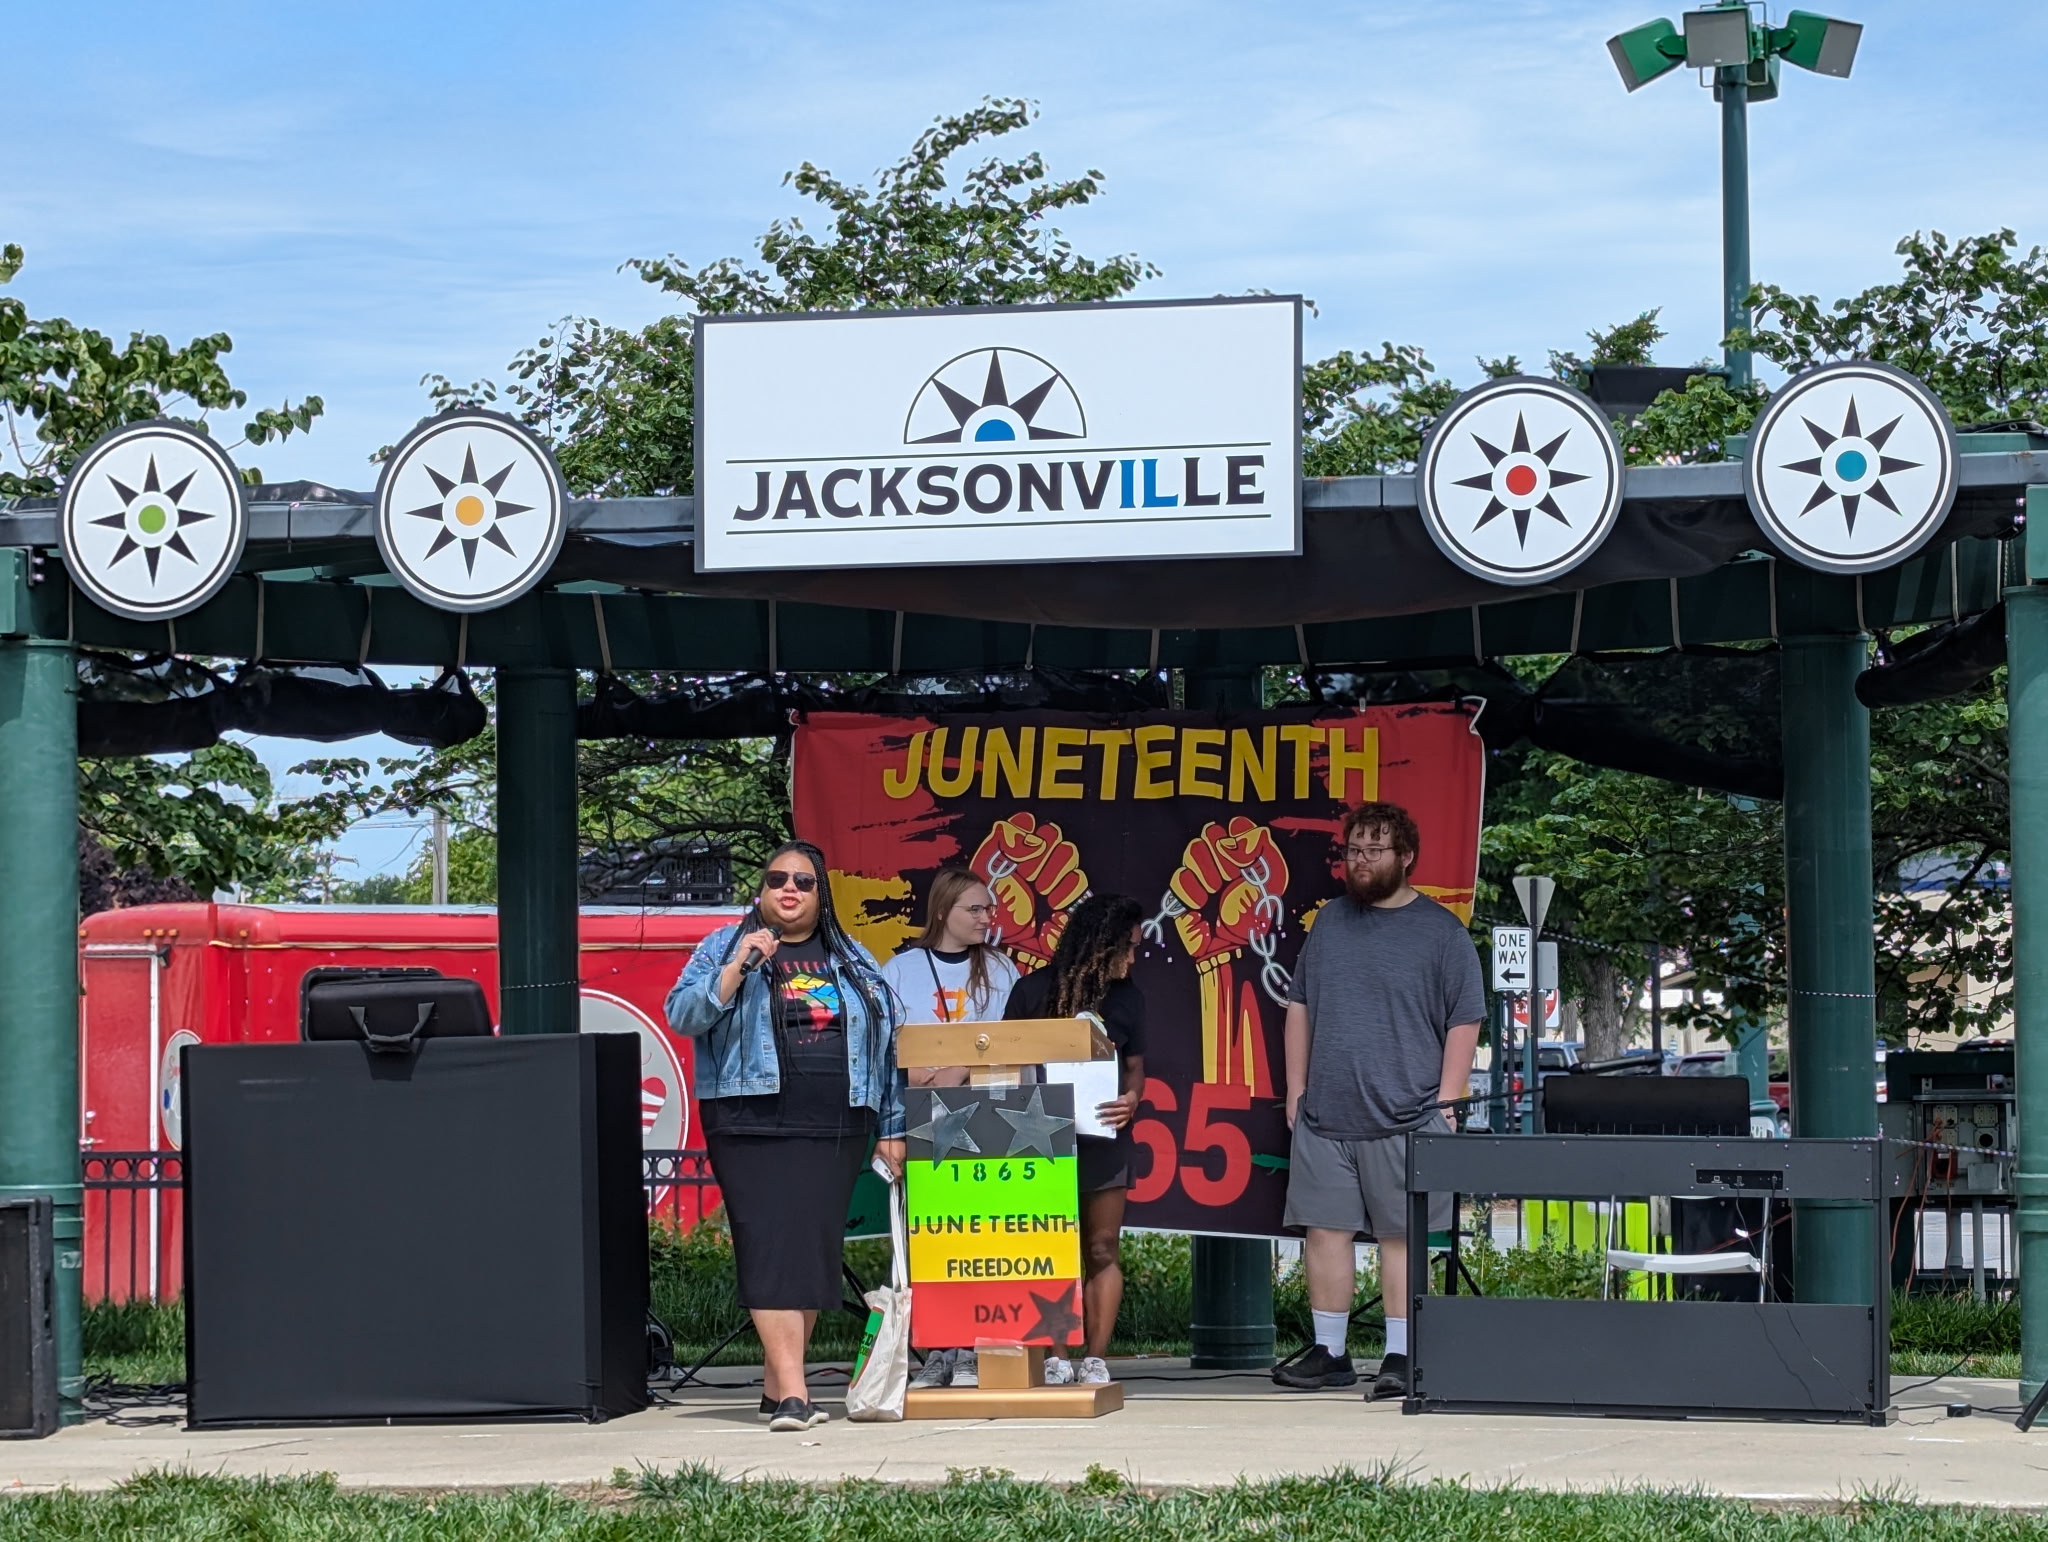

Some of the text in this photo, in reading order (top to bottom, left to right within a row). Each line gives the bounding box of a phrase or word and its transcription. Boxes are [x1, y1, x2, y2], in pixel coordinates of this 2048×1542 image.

[733, 454, 1266, 523] JACKSONVILLE
[883, 725, 1379, 802] JUNETEENTH
[1498, 933, 1526, 948] ONE
[1498, 950, 1527, 965] WAY
[951, 1162, 1036, 1182] 1865
[910, 1213, 1079, 1235] JUNETEENTH
[946, 1257, 1055, 1278] FREEDOM
[974, 1303, 1024, 1324] DAY
